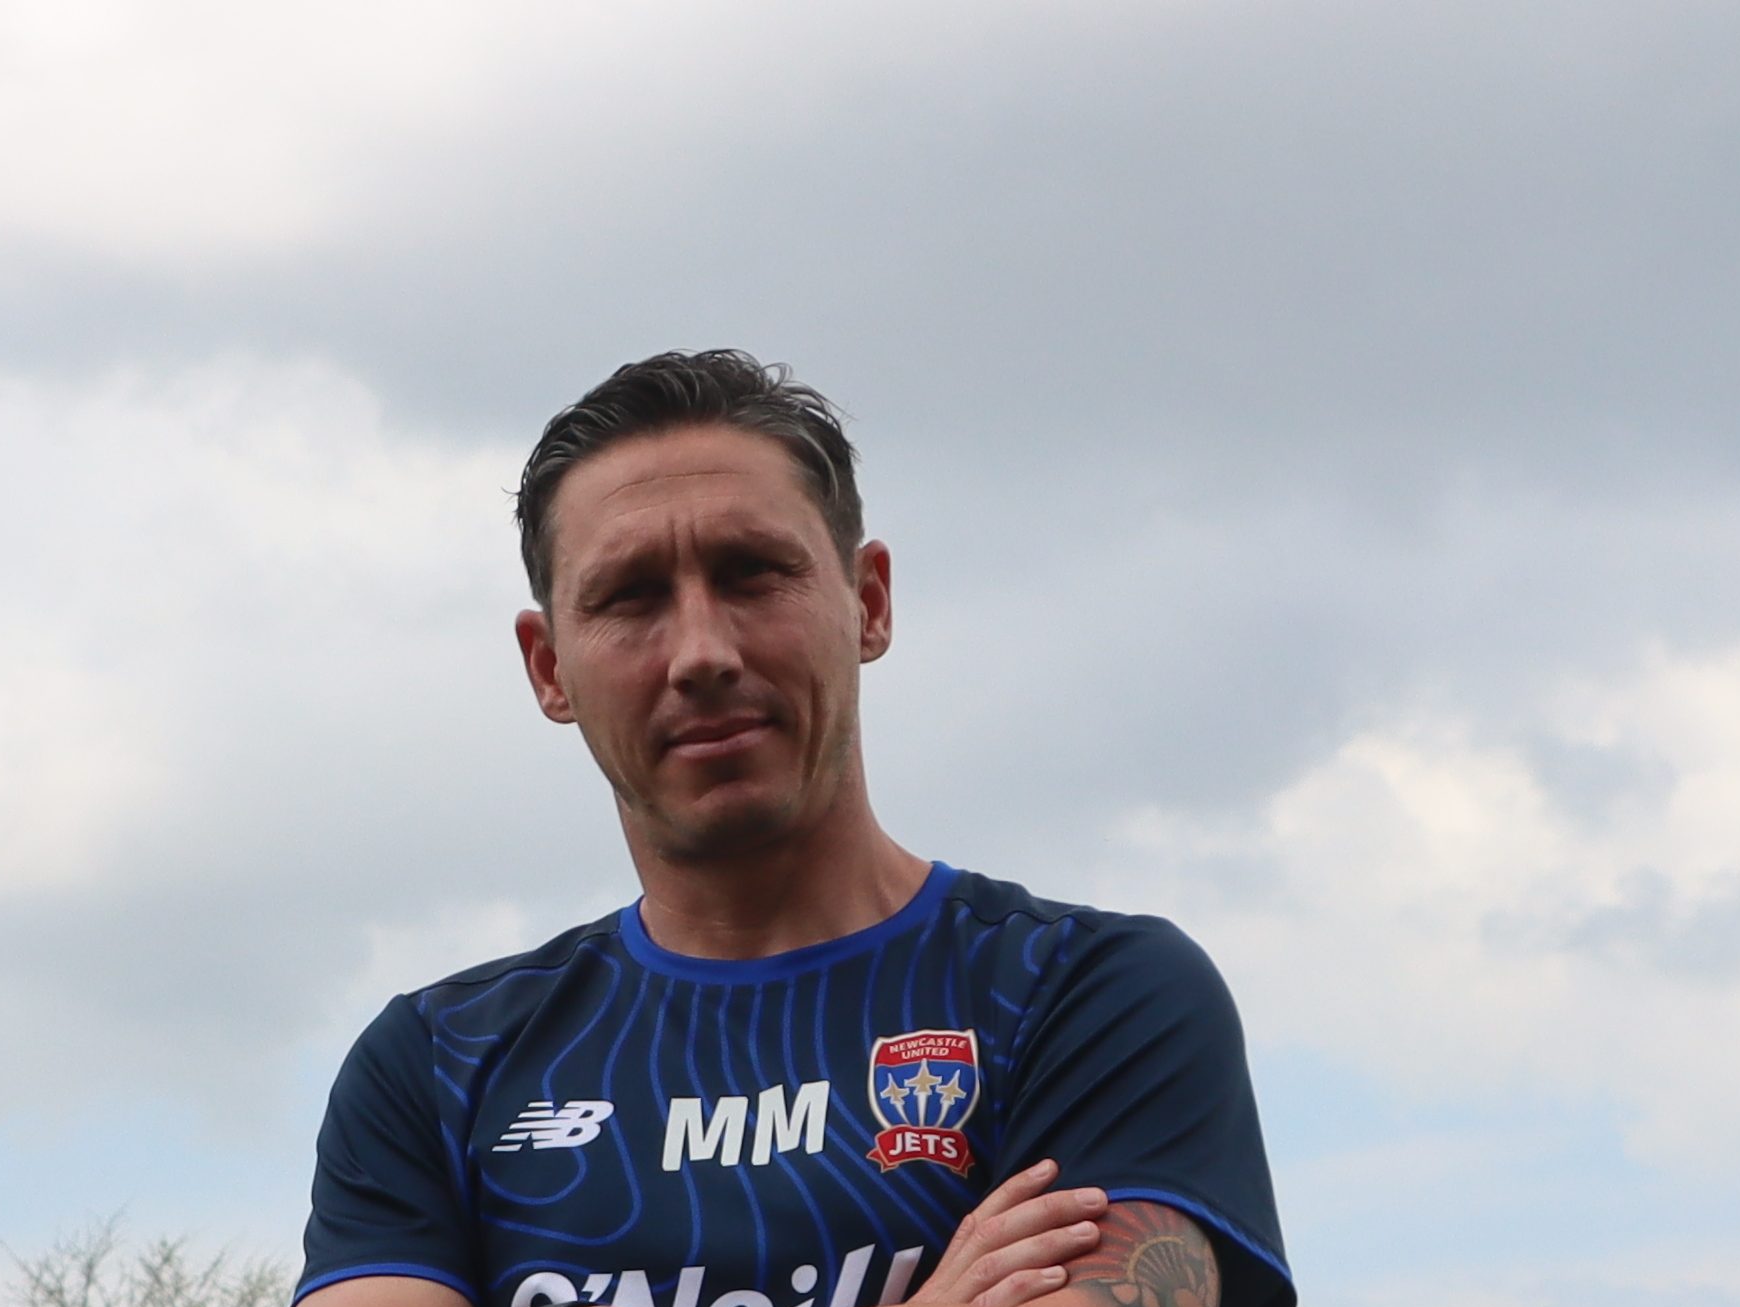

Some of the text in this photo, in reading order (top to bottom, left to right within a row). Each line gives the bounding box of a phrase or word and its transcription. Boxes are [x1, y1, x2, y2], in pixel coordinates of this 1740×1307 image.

[889, 1037, 967, 1054] NEWCASTLE
[901, 1047, 949, 1060] UNITED
[661, 1080, 830, 1172] MM
[889, 1131, 958, 1159] JETS
